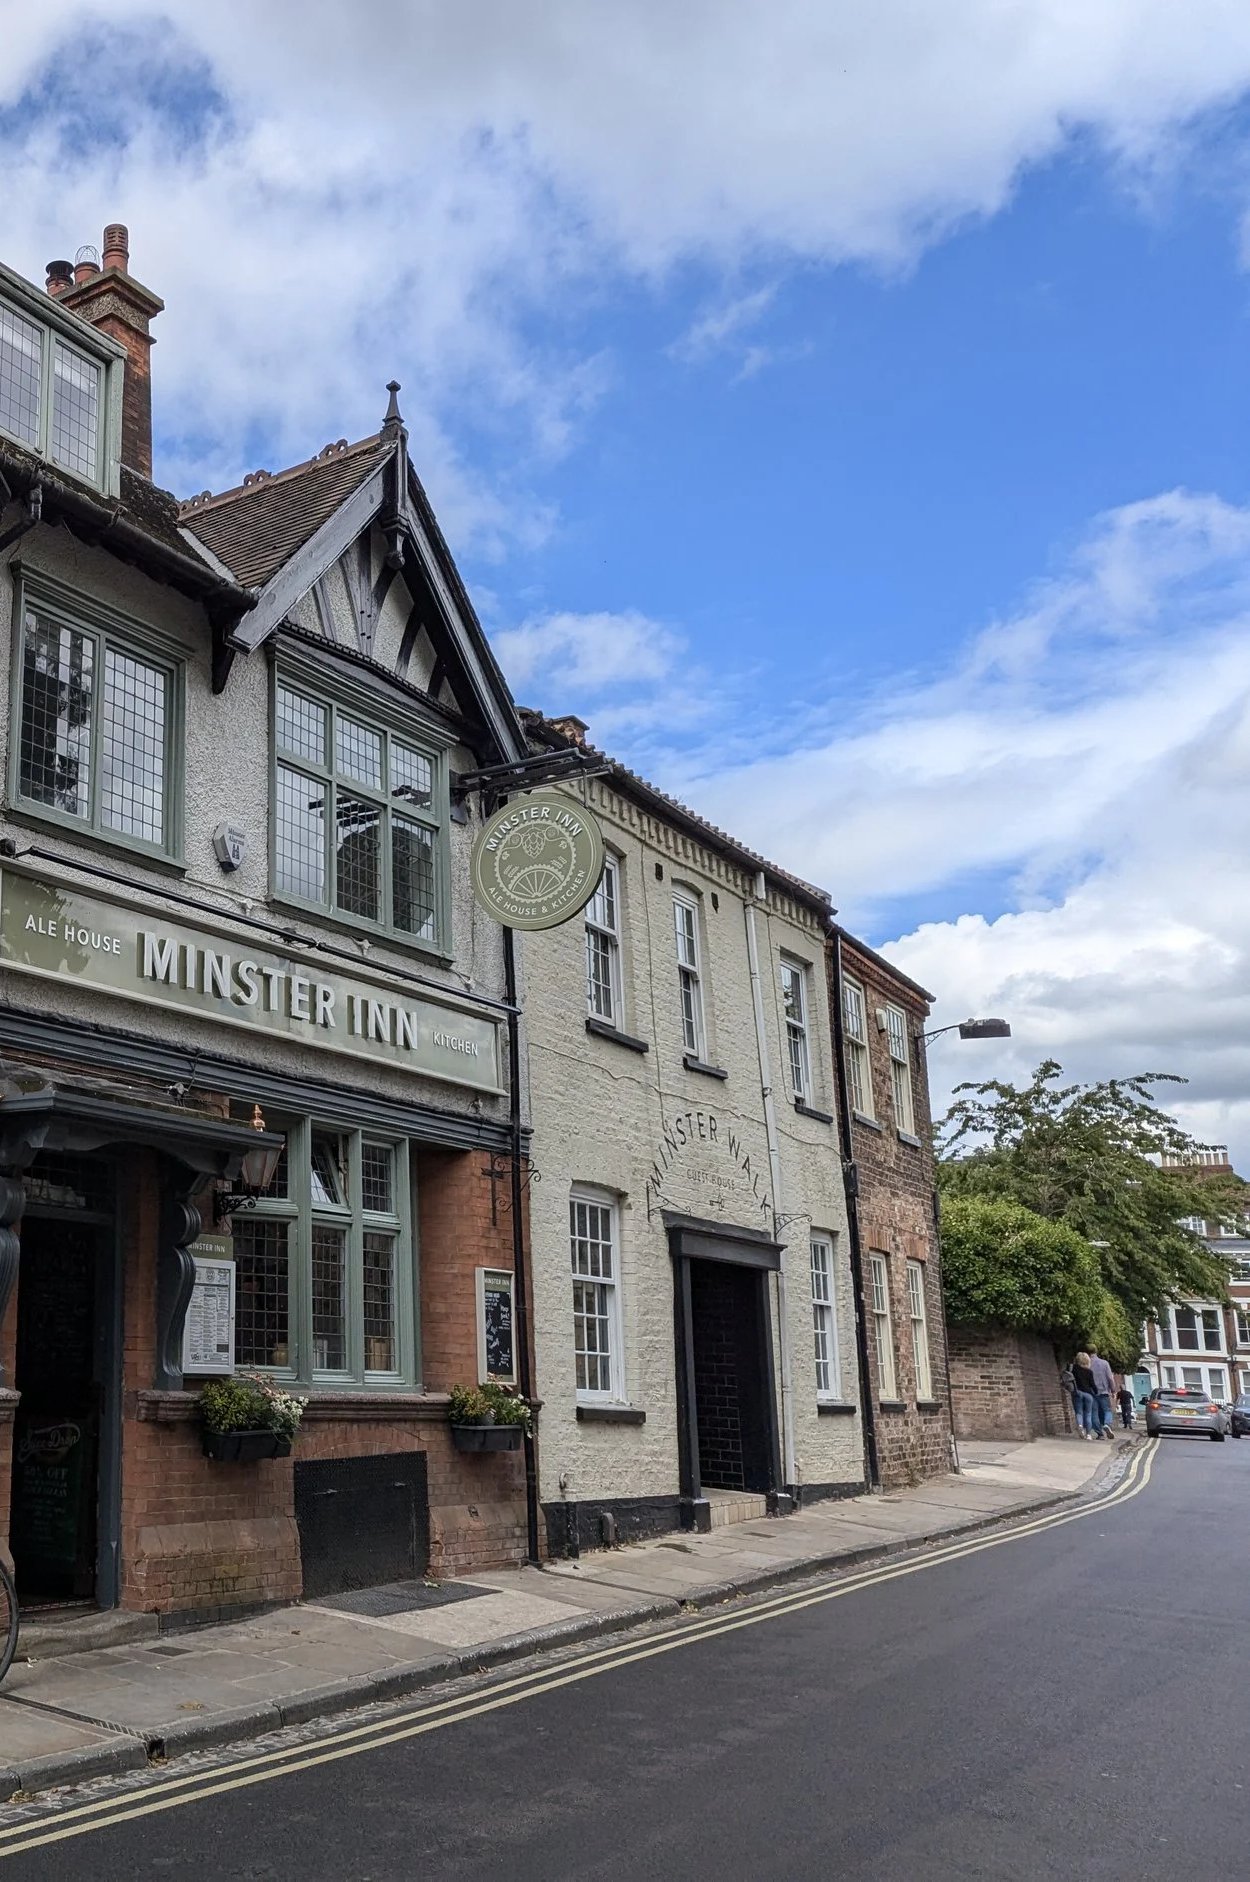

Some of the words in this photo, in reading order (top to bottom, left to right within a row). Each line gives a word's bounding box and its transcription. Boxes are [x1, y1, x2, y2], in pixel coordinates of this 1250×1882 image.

[486, 807, 550, 851] MINSTER
[555, 810, 582, 837] INN
[488, 886, 503, 902] ALE
[503, 900, 537, 915] HOUSE
[541, 906, 548, 914] &
[552, 869, 586, 909] KITCHEN
[24, 913, 58, 938] ALE
[64, 923, 122, 956] HOUSE
[140, 930, 337, 1029] MINSTER
[350, 993, 419, 1051] INN
[432, 1029, 479, 1058] KITCHEN
[650, 1112, 718, 1197] MINSTER
[727, 1128, 771, 1221] WALK
[687, 1169, 708, 1183] GUEST
[711, 1174, 735, 1190] HOUSE
[214, 1244, 226, 1253] INN
